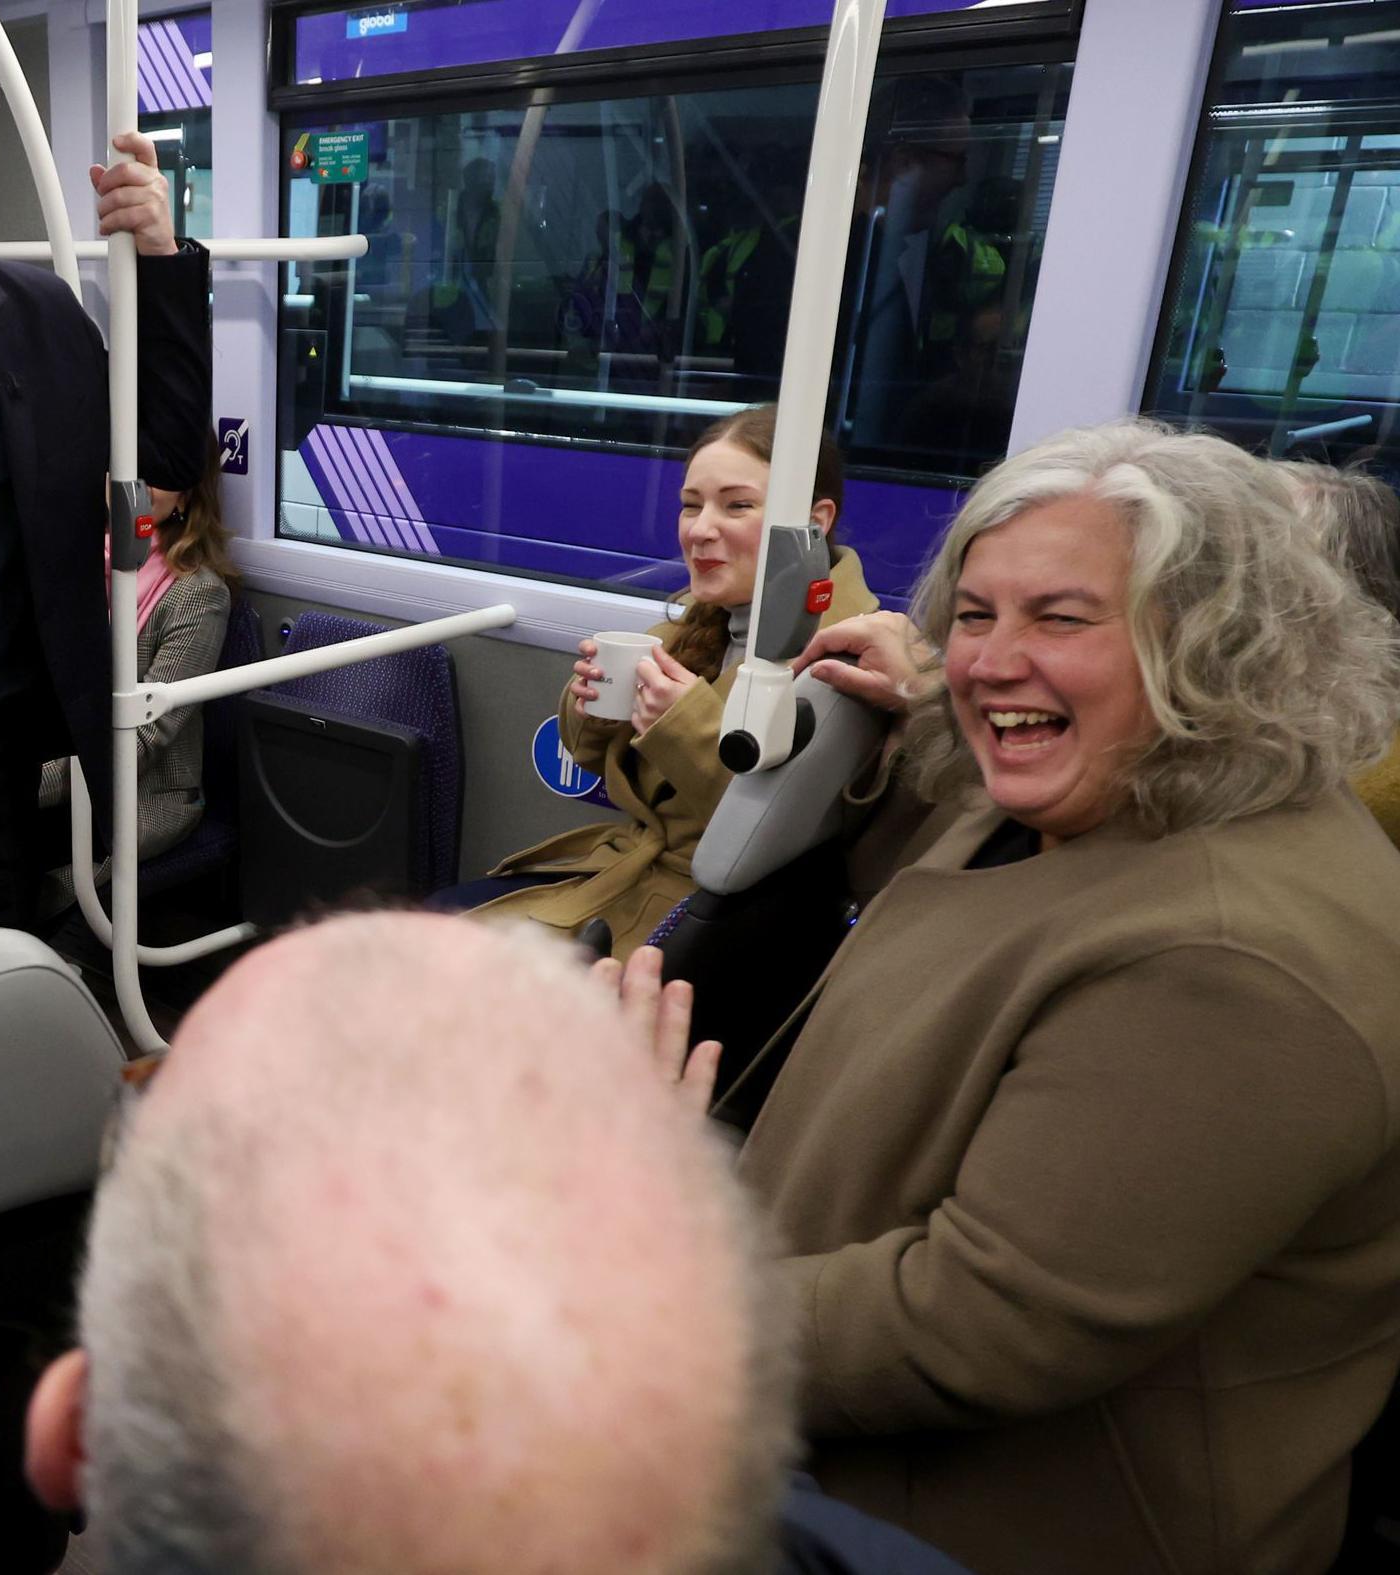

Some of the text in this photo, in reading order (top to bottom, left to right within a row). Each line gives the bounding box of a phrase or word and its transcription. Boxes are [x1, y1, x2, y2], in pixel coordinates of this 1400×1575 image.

[360, 10, 395, 36] global
[319, 135, 351, 145] EMERGENCY
[237, 454, 244, 465] T
